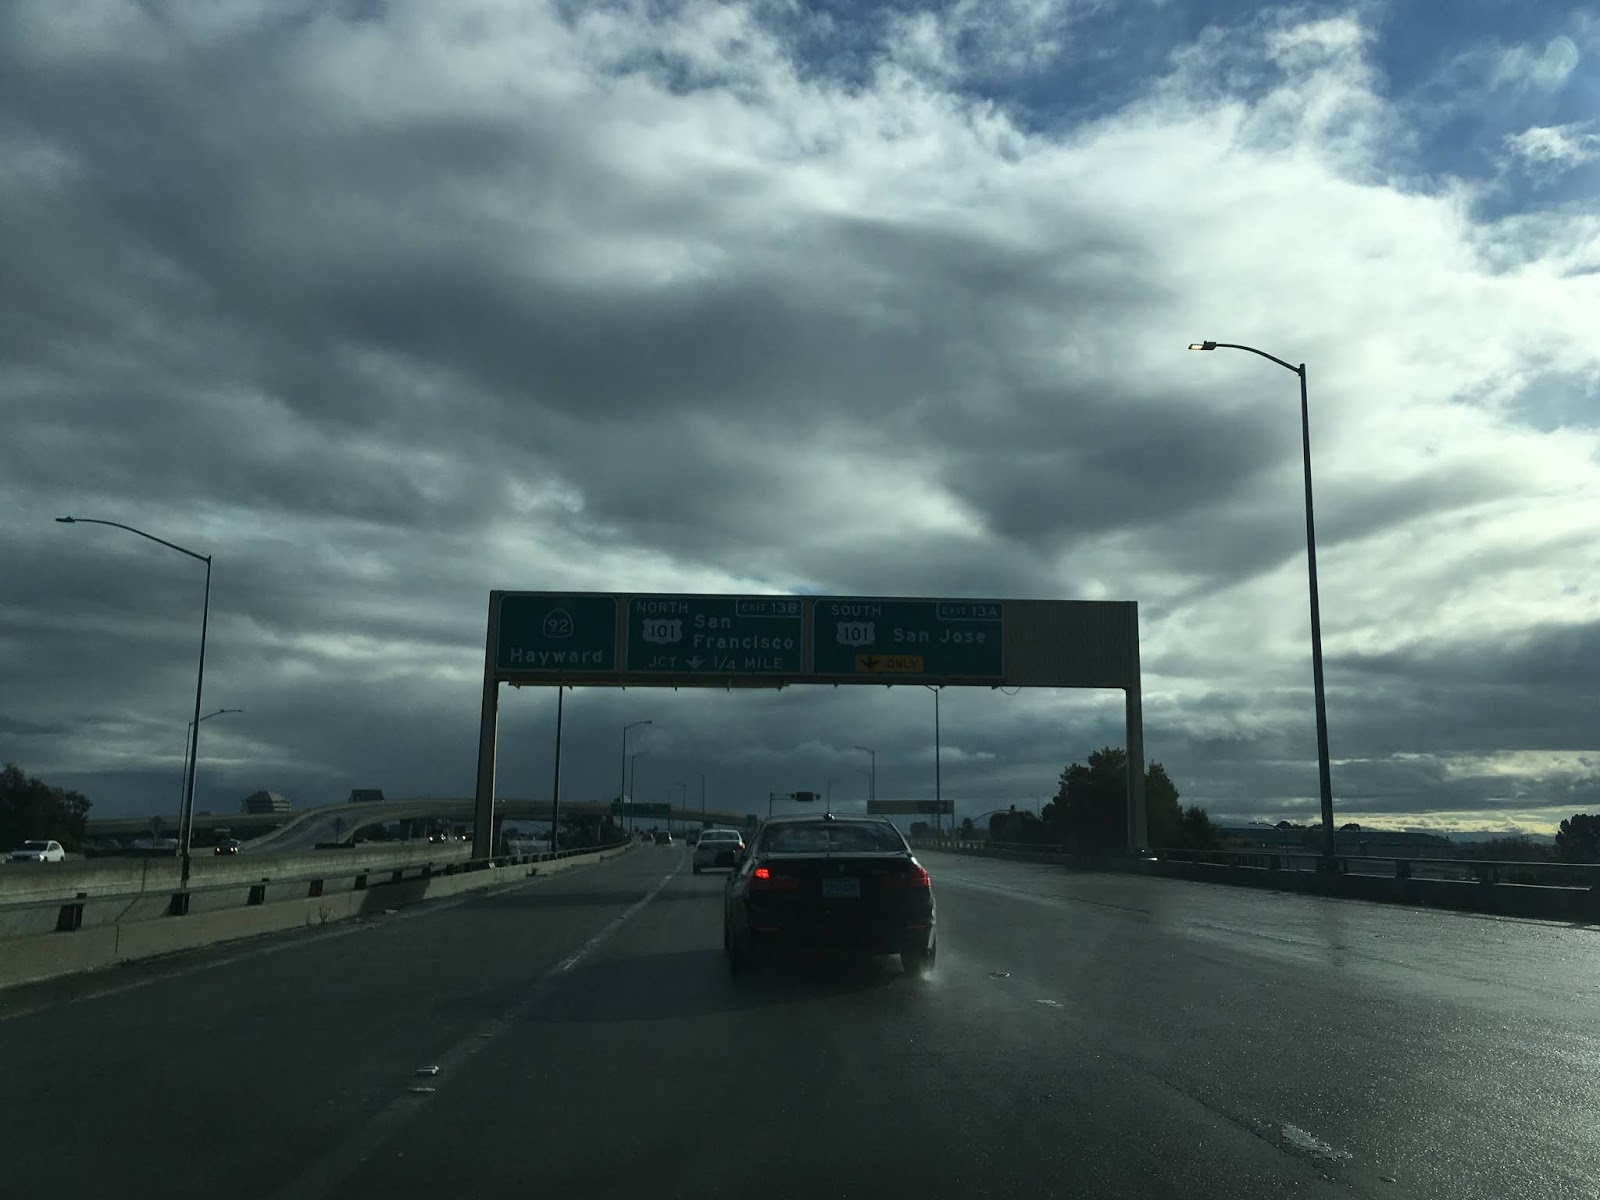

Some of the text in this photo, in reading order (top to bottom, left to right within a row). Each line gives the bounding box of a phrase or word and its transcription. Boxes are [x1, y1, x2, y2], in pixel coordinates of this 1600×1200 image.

[636, 601, 689, 614] NORTH
[741, 603, 798, 614] EXIT 13B
[832, 604, 882, 617] SOUTH
[972, 606, 998, 617] 13A
[548, 619, 569, 632] 92
[694, 614, 730, 629] San
[650, 624, 675, 639] 101
[845, 627, 868, 641] 101
[893, 628, 987, 644] San Jose
[694, 633, 795, 650] Francisco
[510, 647, 603, 666] Hayward
[649, 656, 677, 668] JCT
[744, 657, 784, 669] MILE
[888, 659, 919, 669] ONLY
